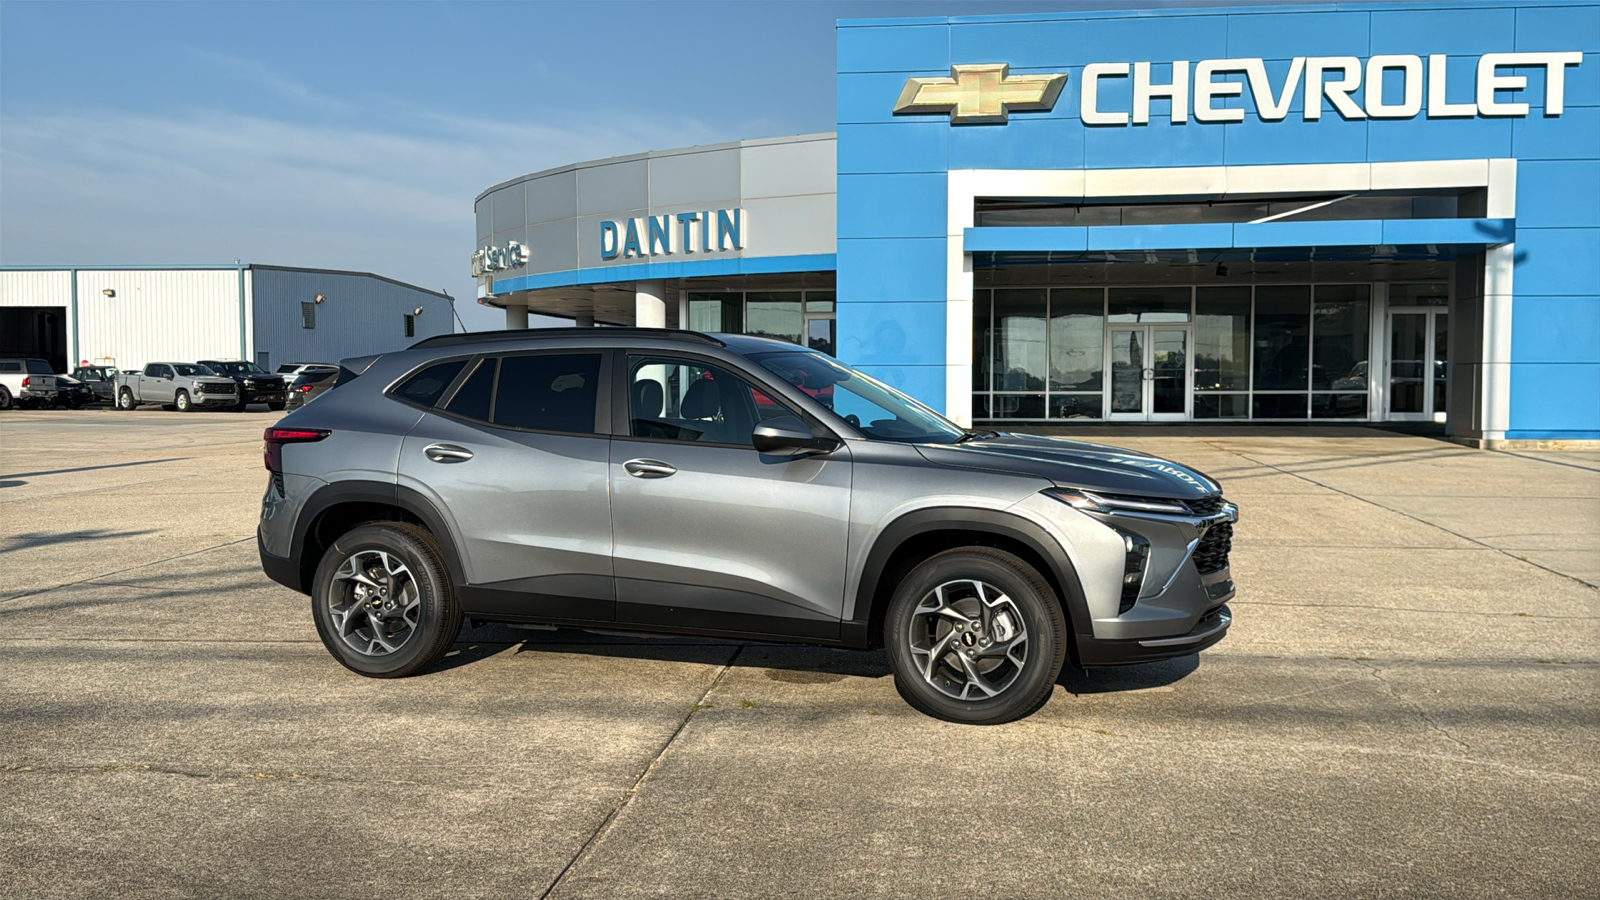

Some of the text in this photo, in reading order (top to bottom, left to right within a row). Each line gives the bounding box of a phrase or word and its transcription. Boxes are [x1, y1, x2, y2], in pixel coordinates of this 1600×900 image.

[1080, 51, 1583, 125] CHEVROLET
[485, 241, 529, 271] Service
[600, 208, 746, 261] DANTIN
